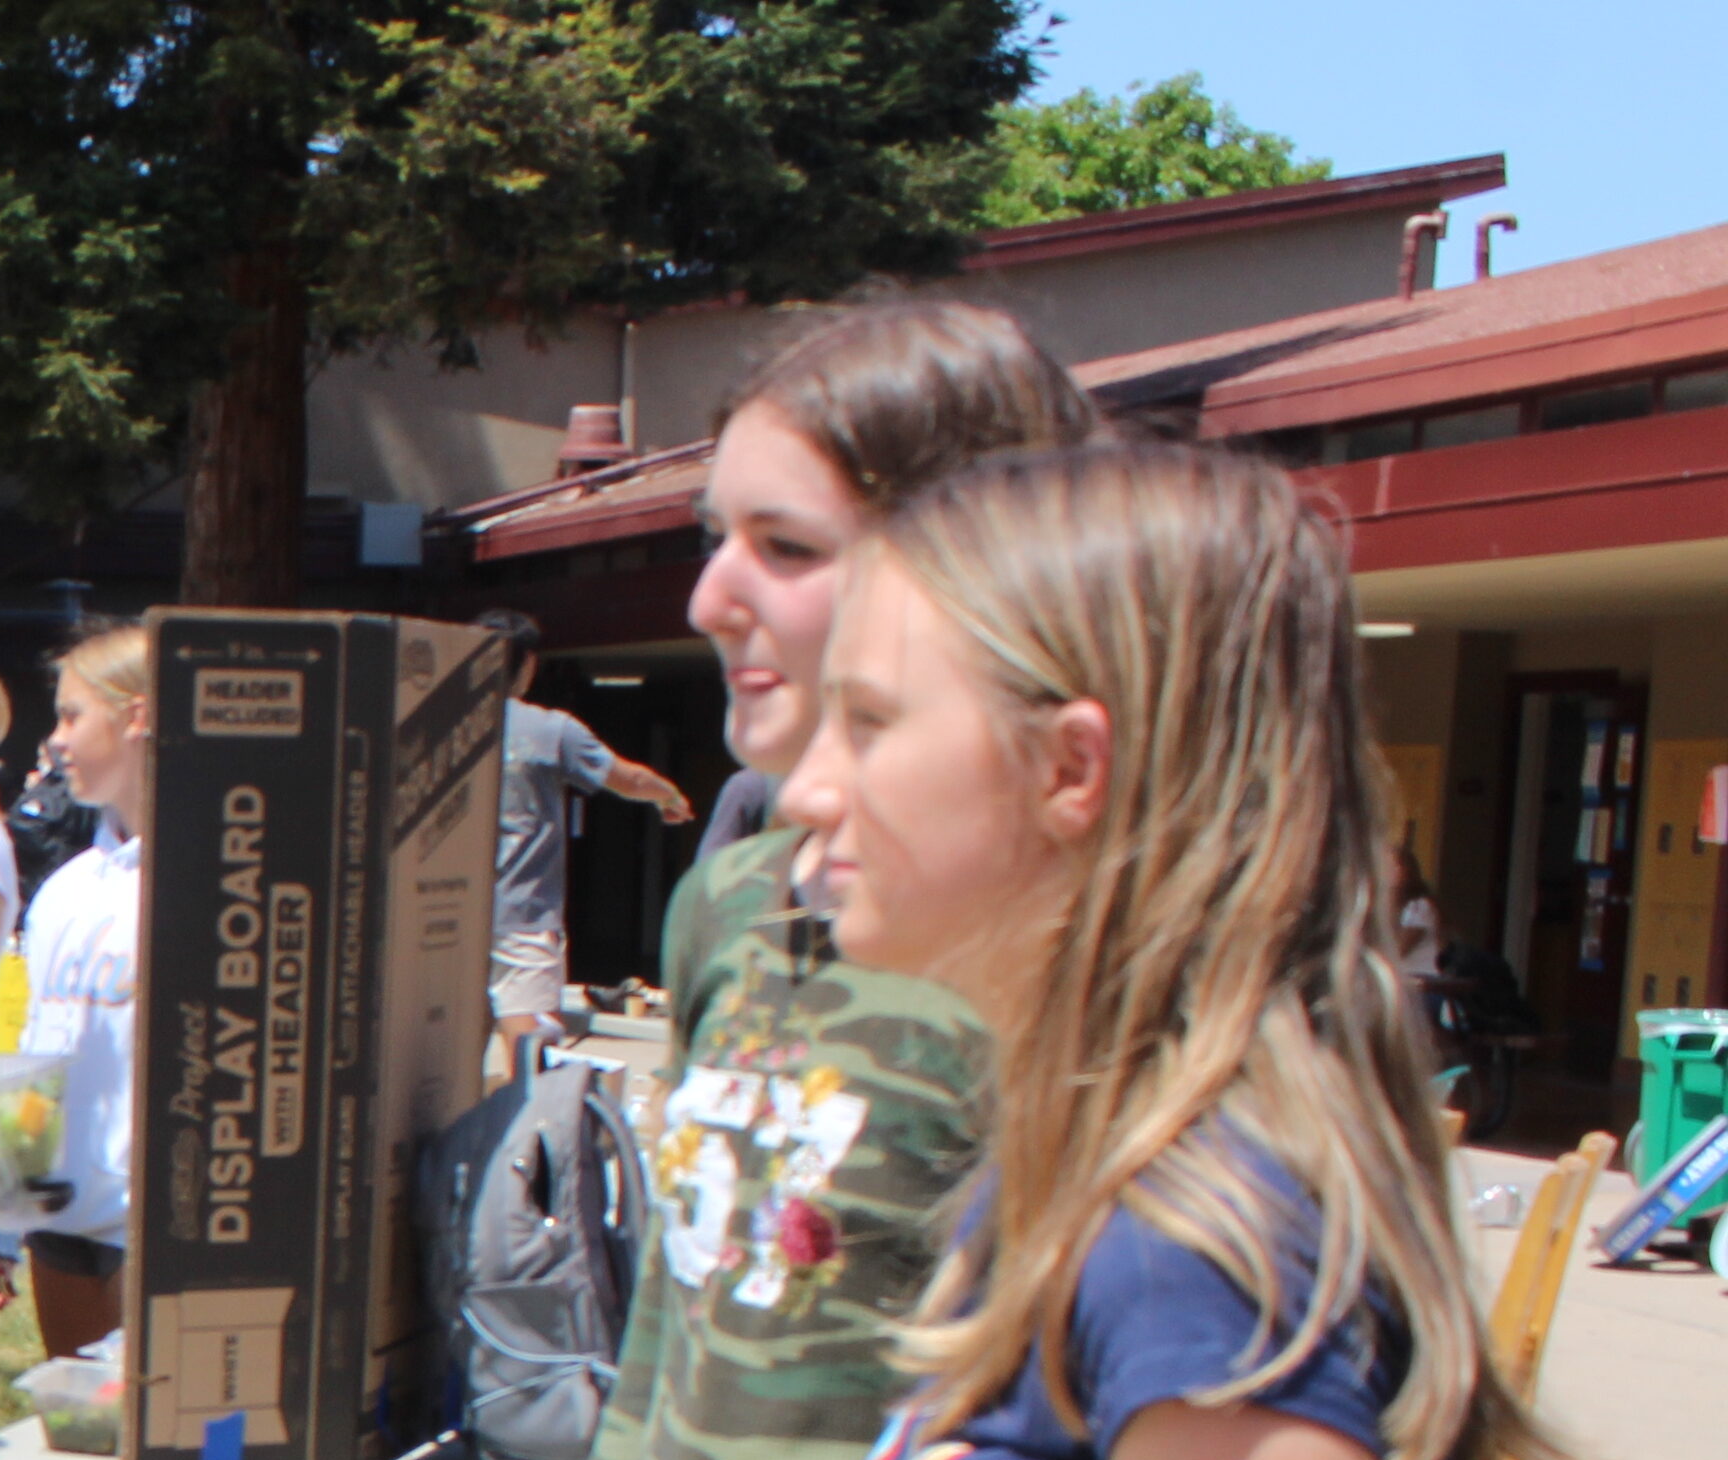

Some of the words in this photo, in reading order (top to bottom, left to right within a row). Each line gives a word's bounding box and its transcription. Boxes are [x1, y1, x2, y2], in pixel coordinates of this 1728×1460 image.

[201, 706, 301, 724] INCLUDED
[205, 681, 291, 699] HEADER
[348, 769, 368, 865] HEADER
[216, 784, 266, 989] BOARD
[341, 871, 364, 1016] ATTACHABLE
[272, 896, 304, 1074] HEADER
[207, 1006, 258, 1243] DISPLAY
[274, 1086, 291, 1146] WITH
